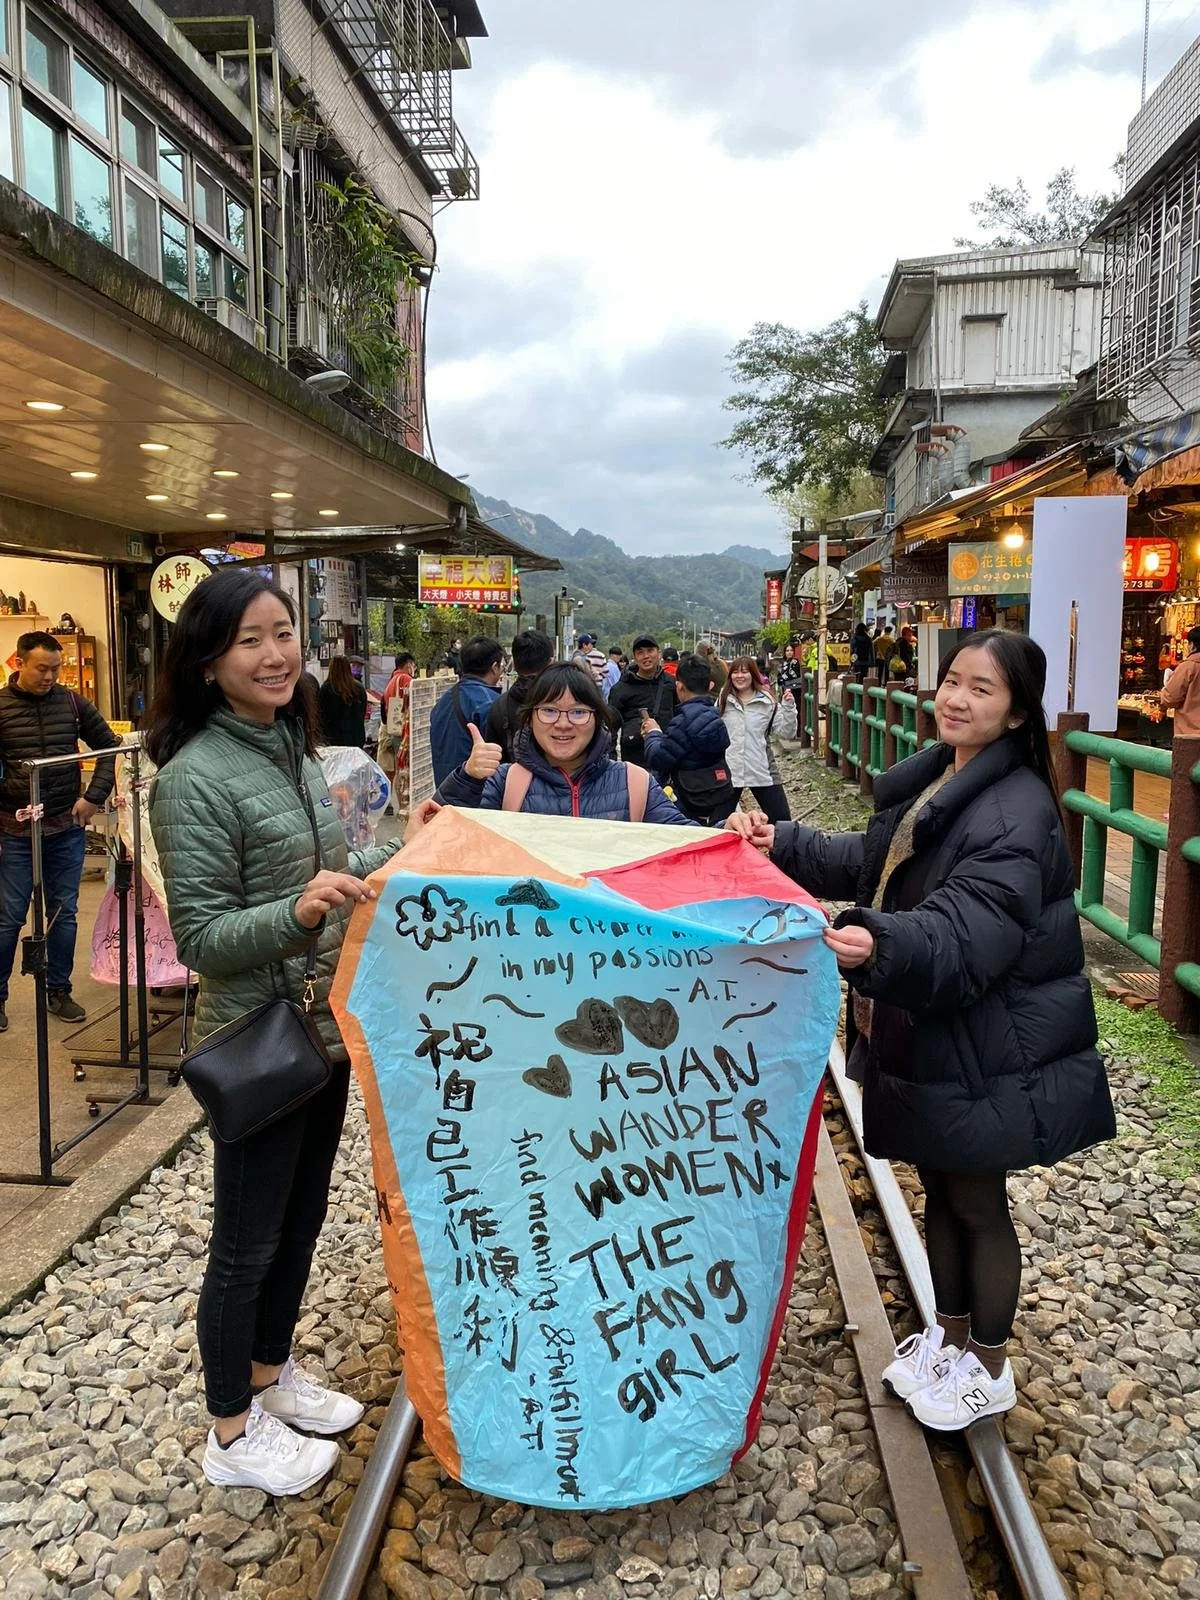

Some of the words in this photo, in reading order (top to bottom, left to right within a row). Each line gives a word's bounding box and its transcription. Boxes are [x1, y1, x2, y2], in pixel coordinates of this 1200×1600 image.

[425, 559, 507, 585] 幸福天燈
[499, 954, 524, 981] in
[588, 945, 714, 980] passions
[597, 1041, 760, 1101] ASIAN
[568, 1097, 781, 1163] WANDER
[568, 1215, 695, 1300] THE
